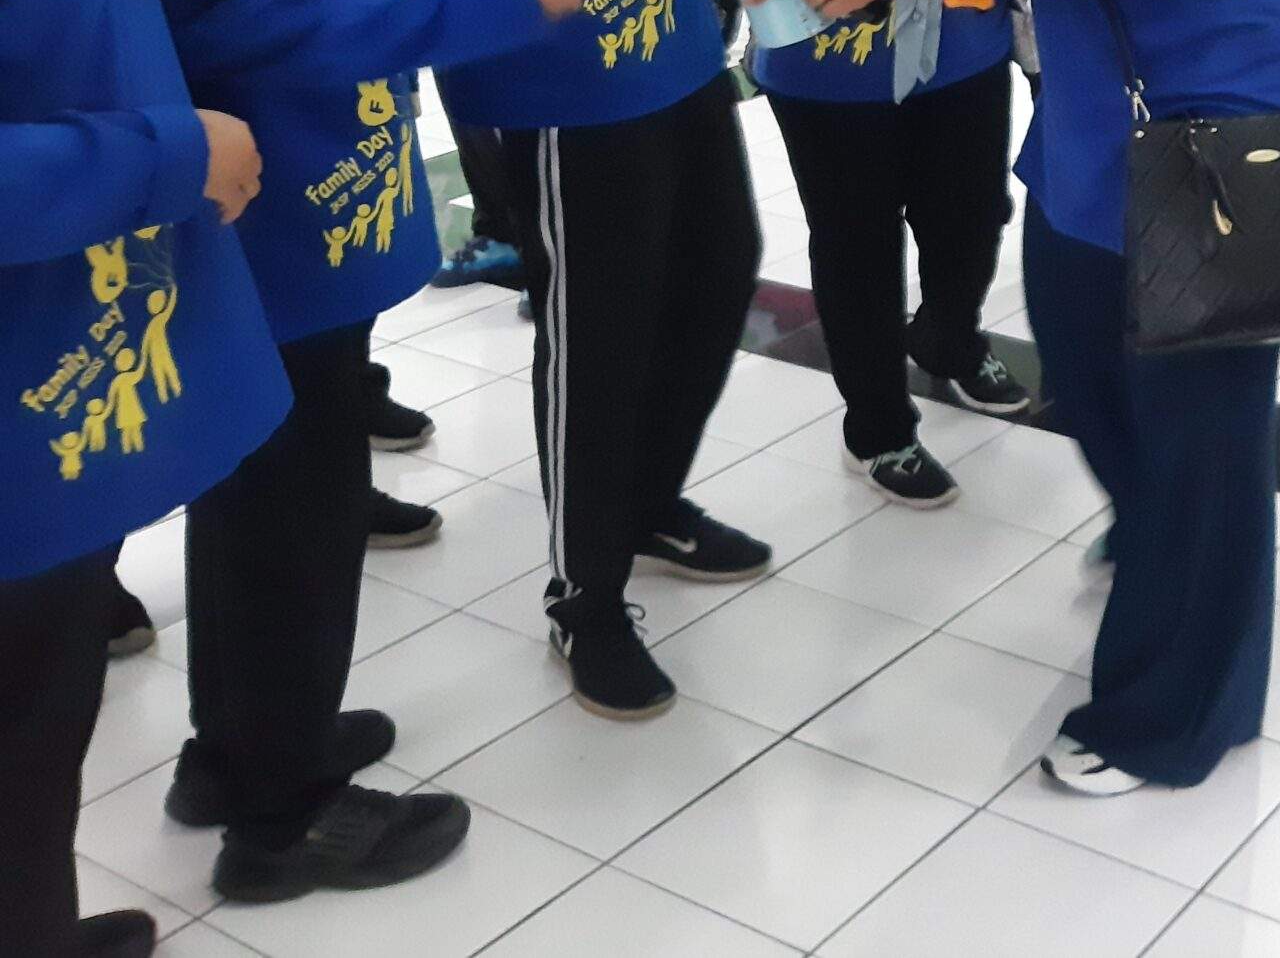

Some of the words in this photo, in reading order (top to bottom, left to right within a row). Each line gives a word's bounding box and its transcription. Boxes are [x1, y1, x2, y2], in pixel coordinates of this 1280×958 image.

[369, 99, 384, 115] F
[304, 156, 363, 206] Family
[356, 125, 394, 159] Day
[20, 345, 91, 413] Family
